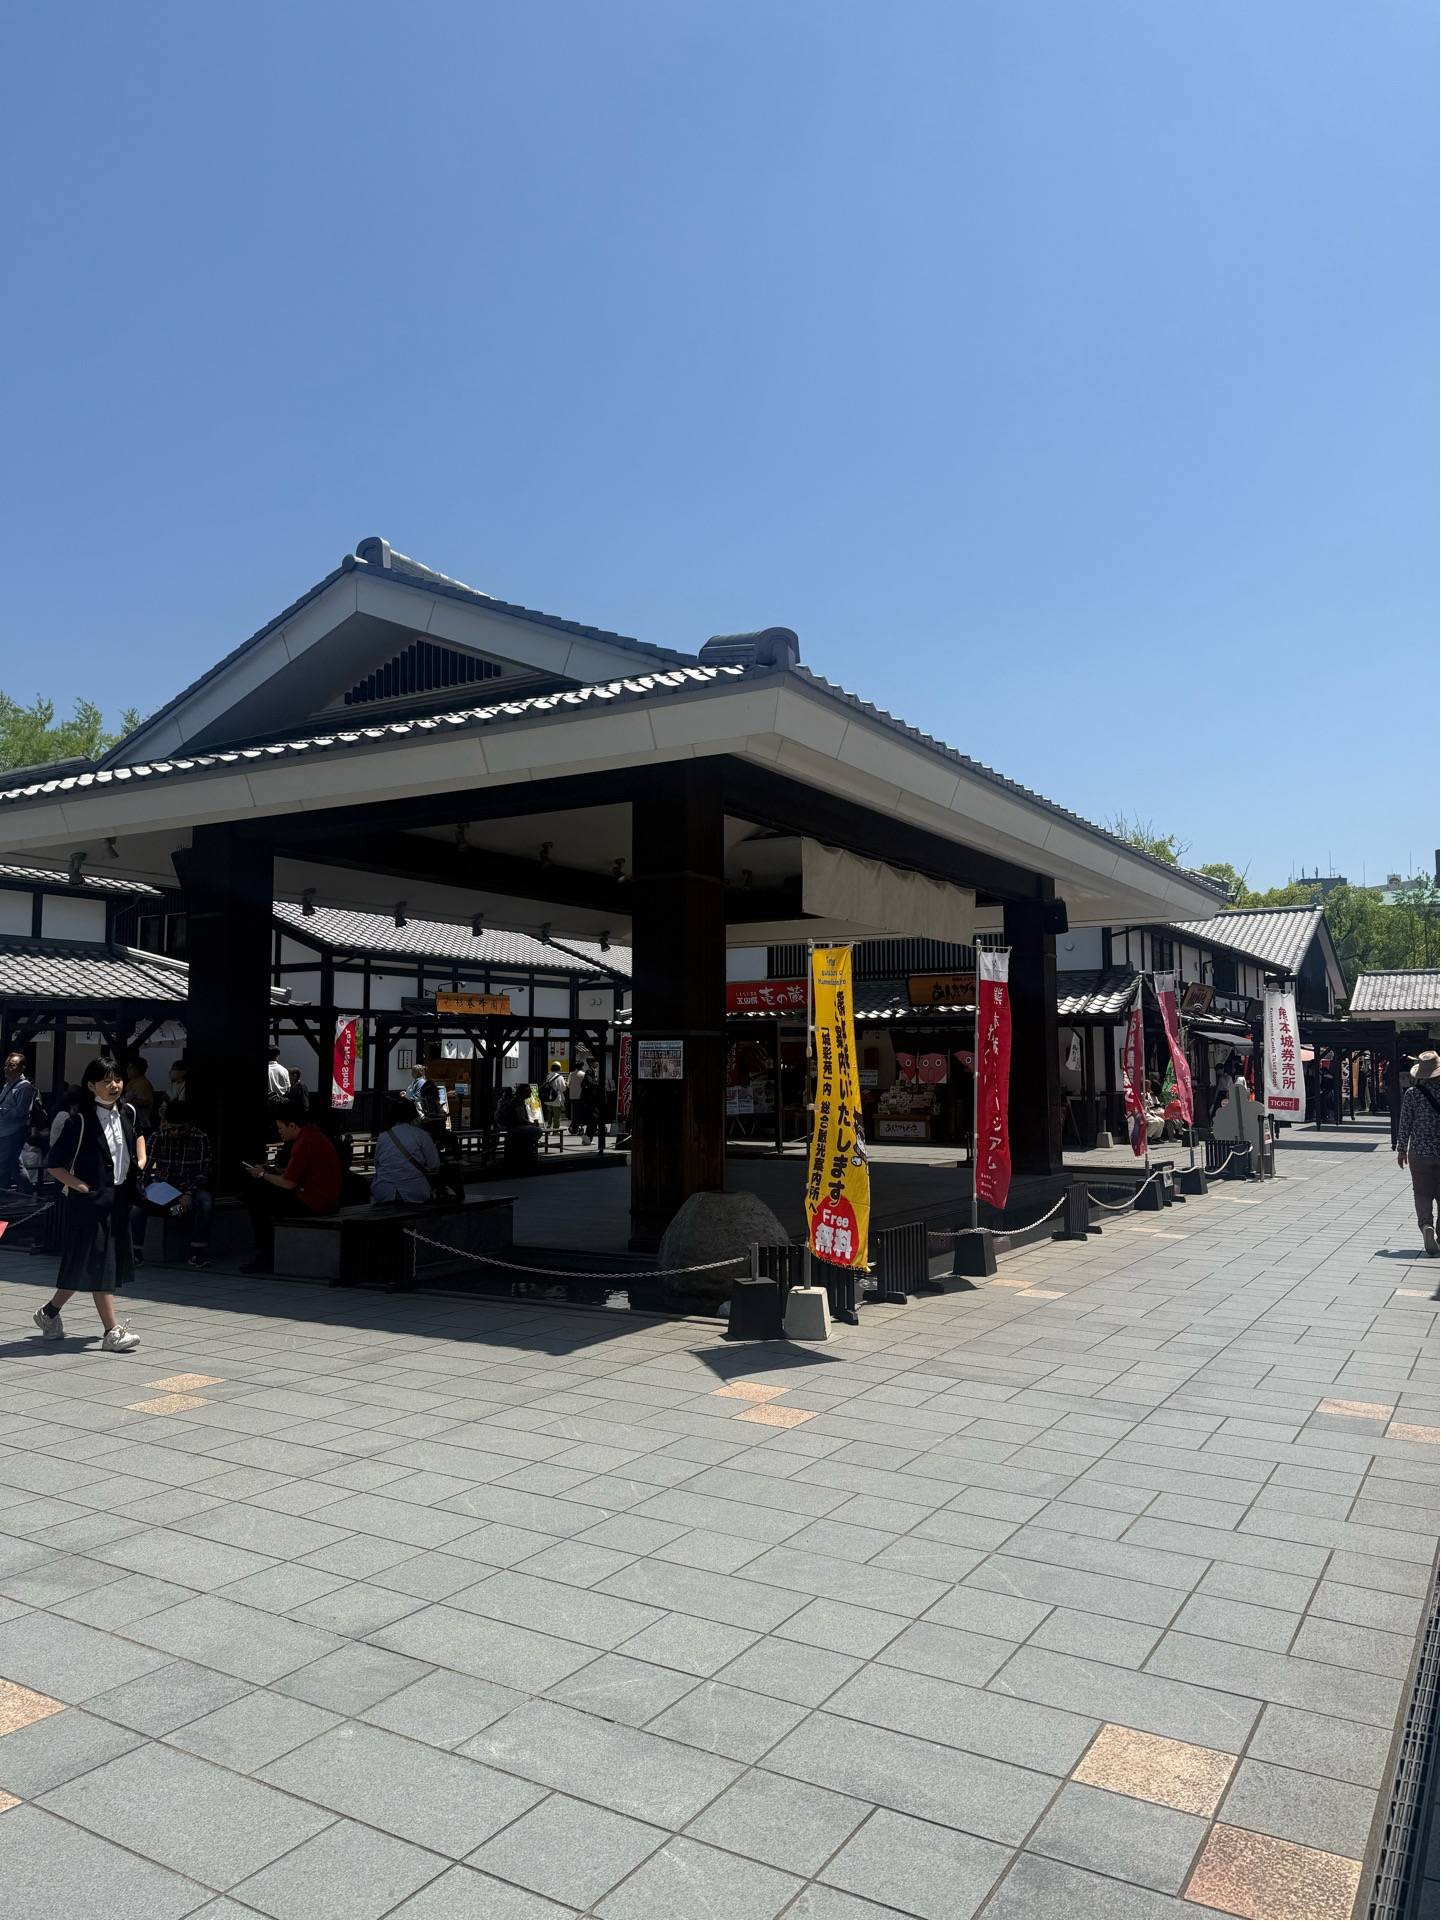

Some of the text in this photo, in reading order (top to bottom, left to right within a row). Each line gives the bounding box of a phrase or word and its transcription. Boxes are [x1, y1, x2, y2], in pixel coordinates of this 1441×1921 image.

[1278, 1006, 1296, 1090] 熊本城券売所
[822, 1208, 849, 1229] Free
[815, 1222, 853, 1260] 無料
